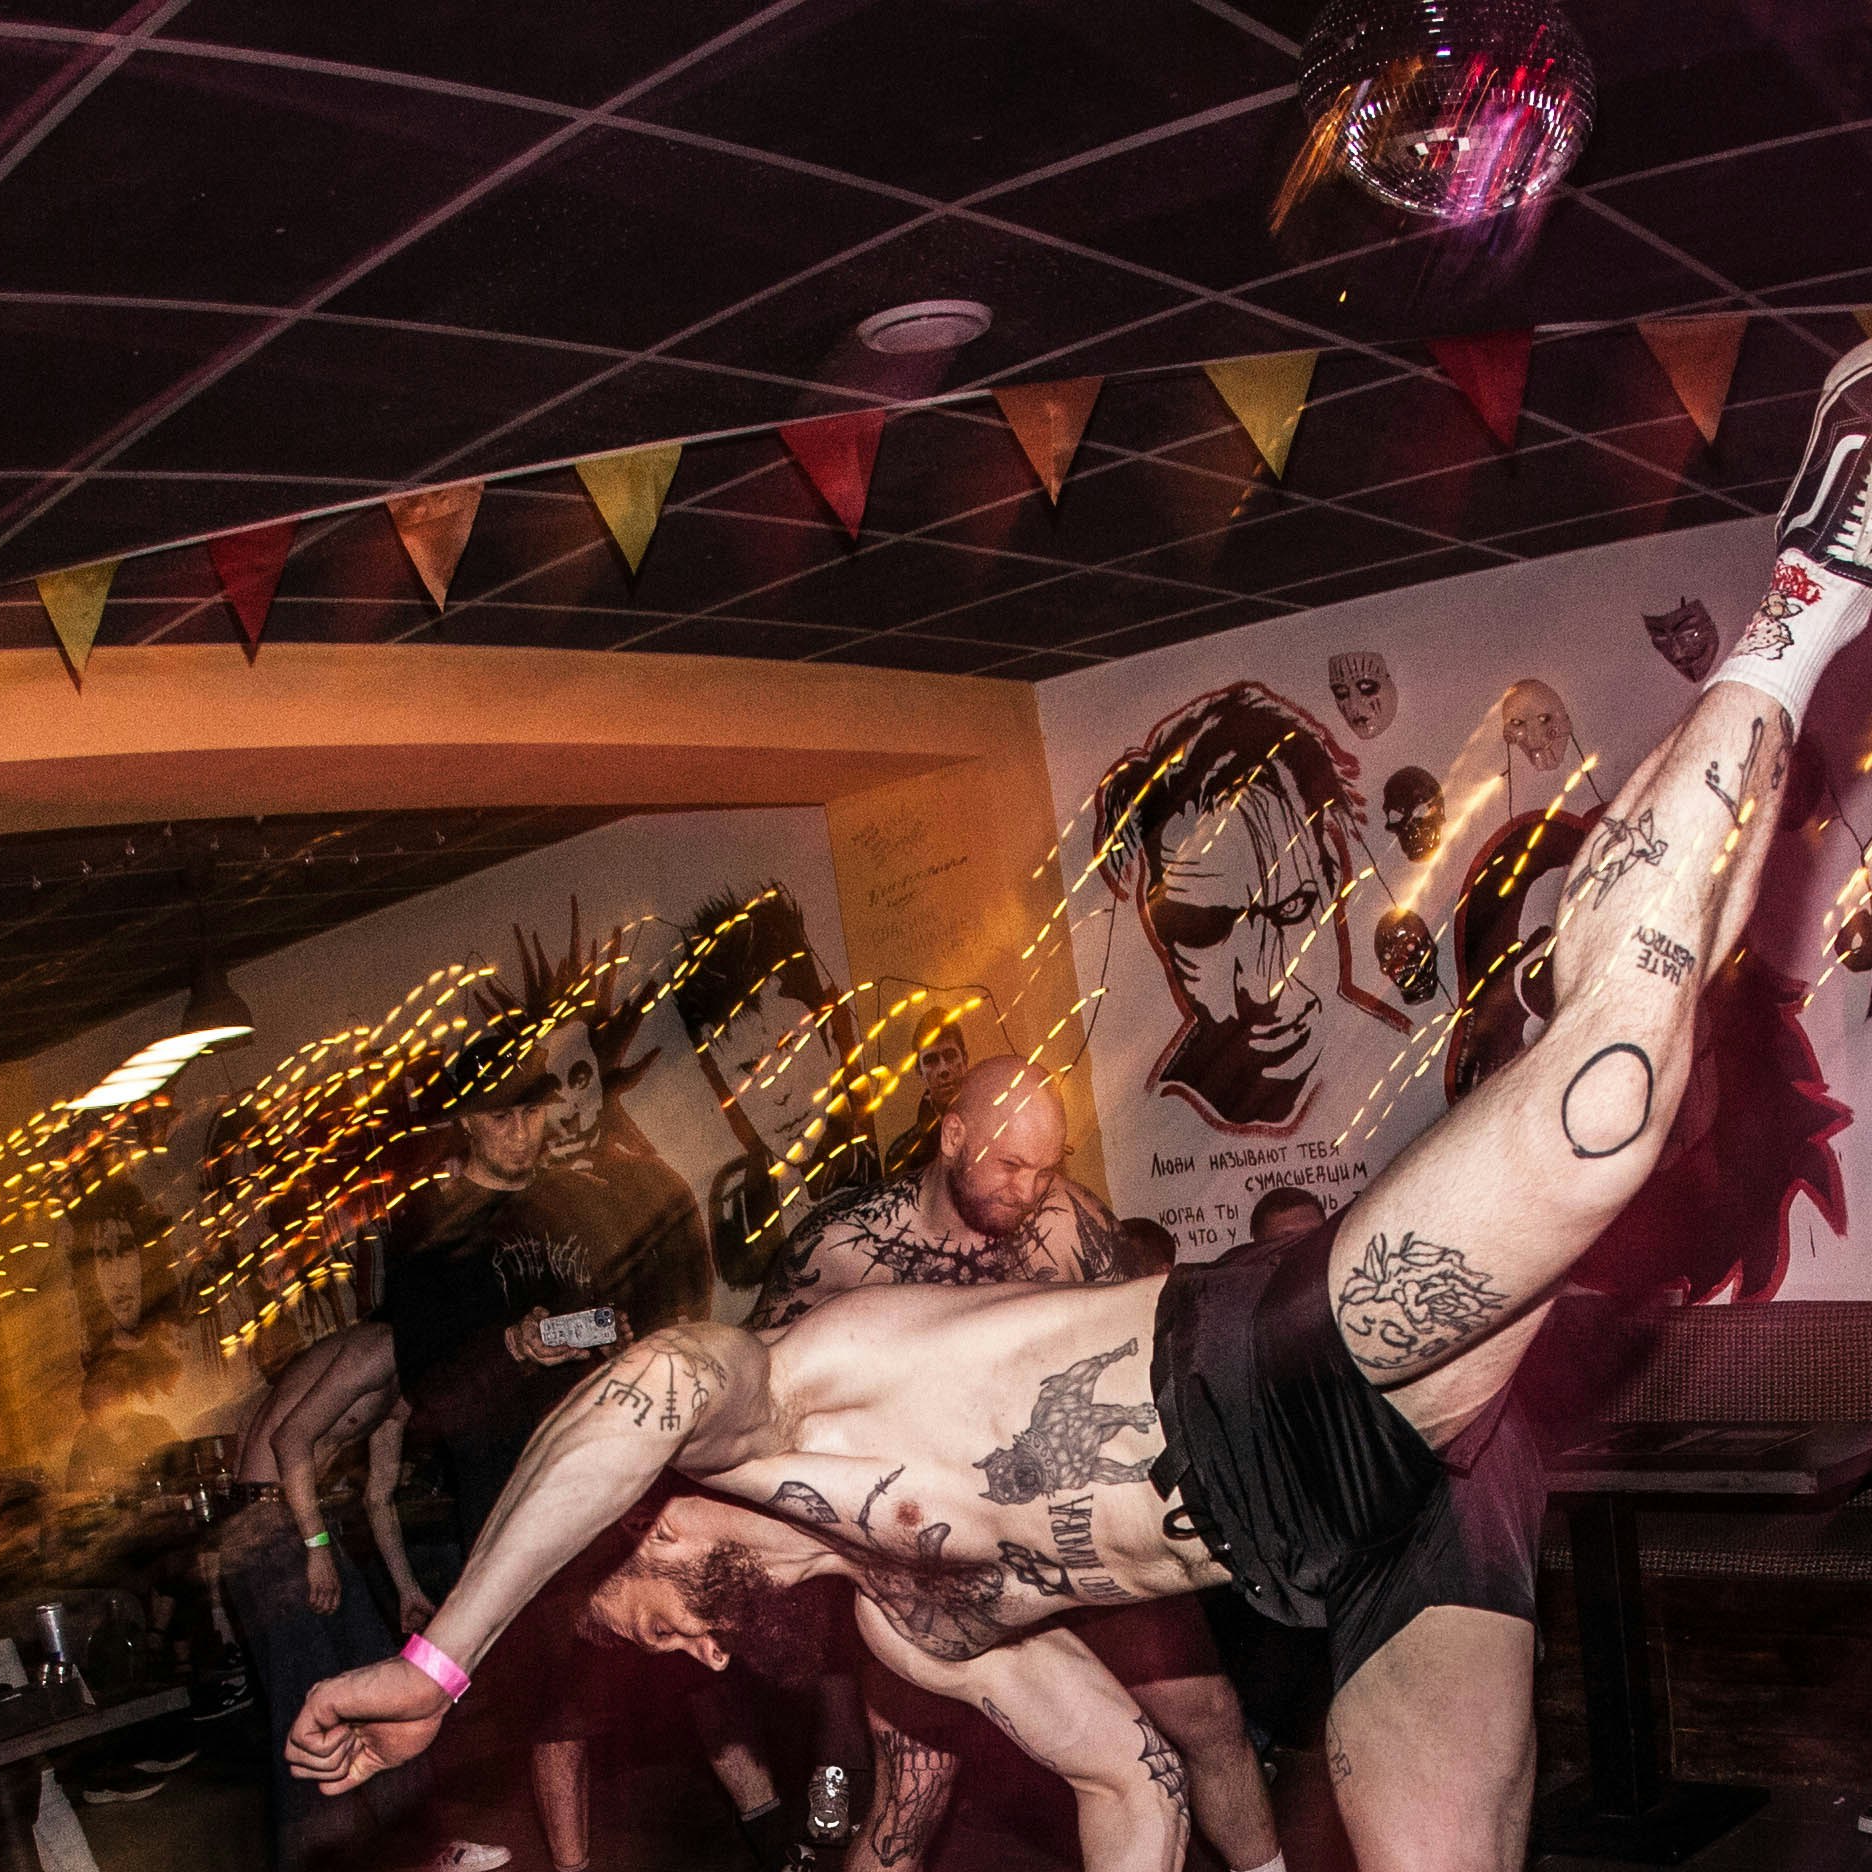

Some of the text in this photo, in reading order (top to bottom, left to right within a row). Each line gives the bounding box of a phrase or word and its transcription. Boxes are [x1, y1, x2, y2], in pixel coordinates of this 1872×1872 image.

[1631, 926, 1696, 974] DESTROY
[1636, 948, 1682, 986] HATE
[1209, 1146, 1287, 1171] НАЗЫВАЮТ
[1297, 1139, 1341, 1160] ТЕБЯ
[1158, 1204, 1239, 1226] КОГДА ТЫ
[1188, 1229, 1218, 1247] ЧТО
